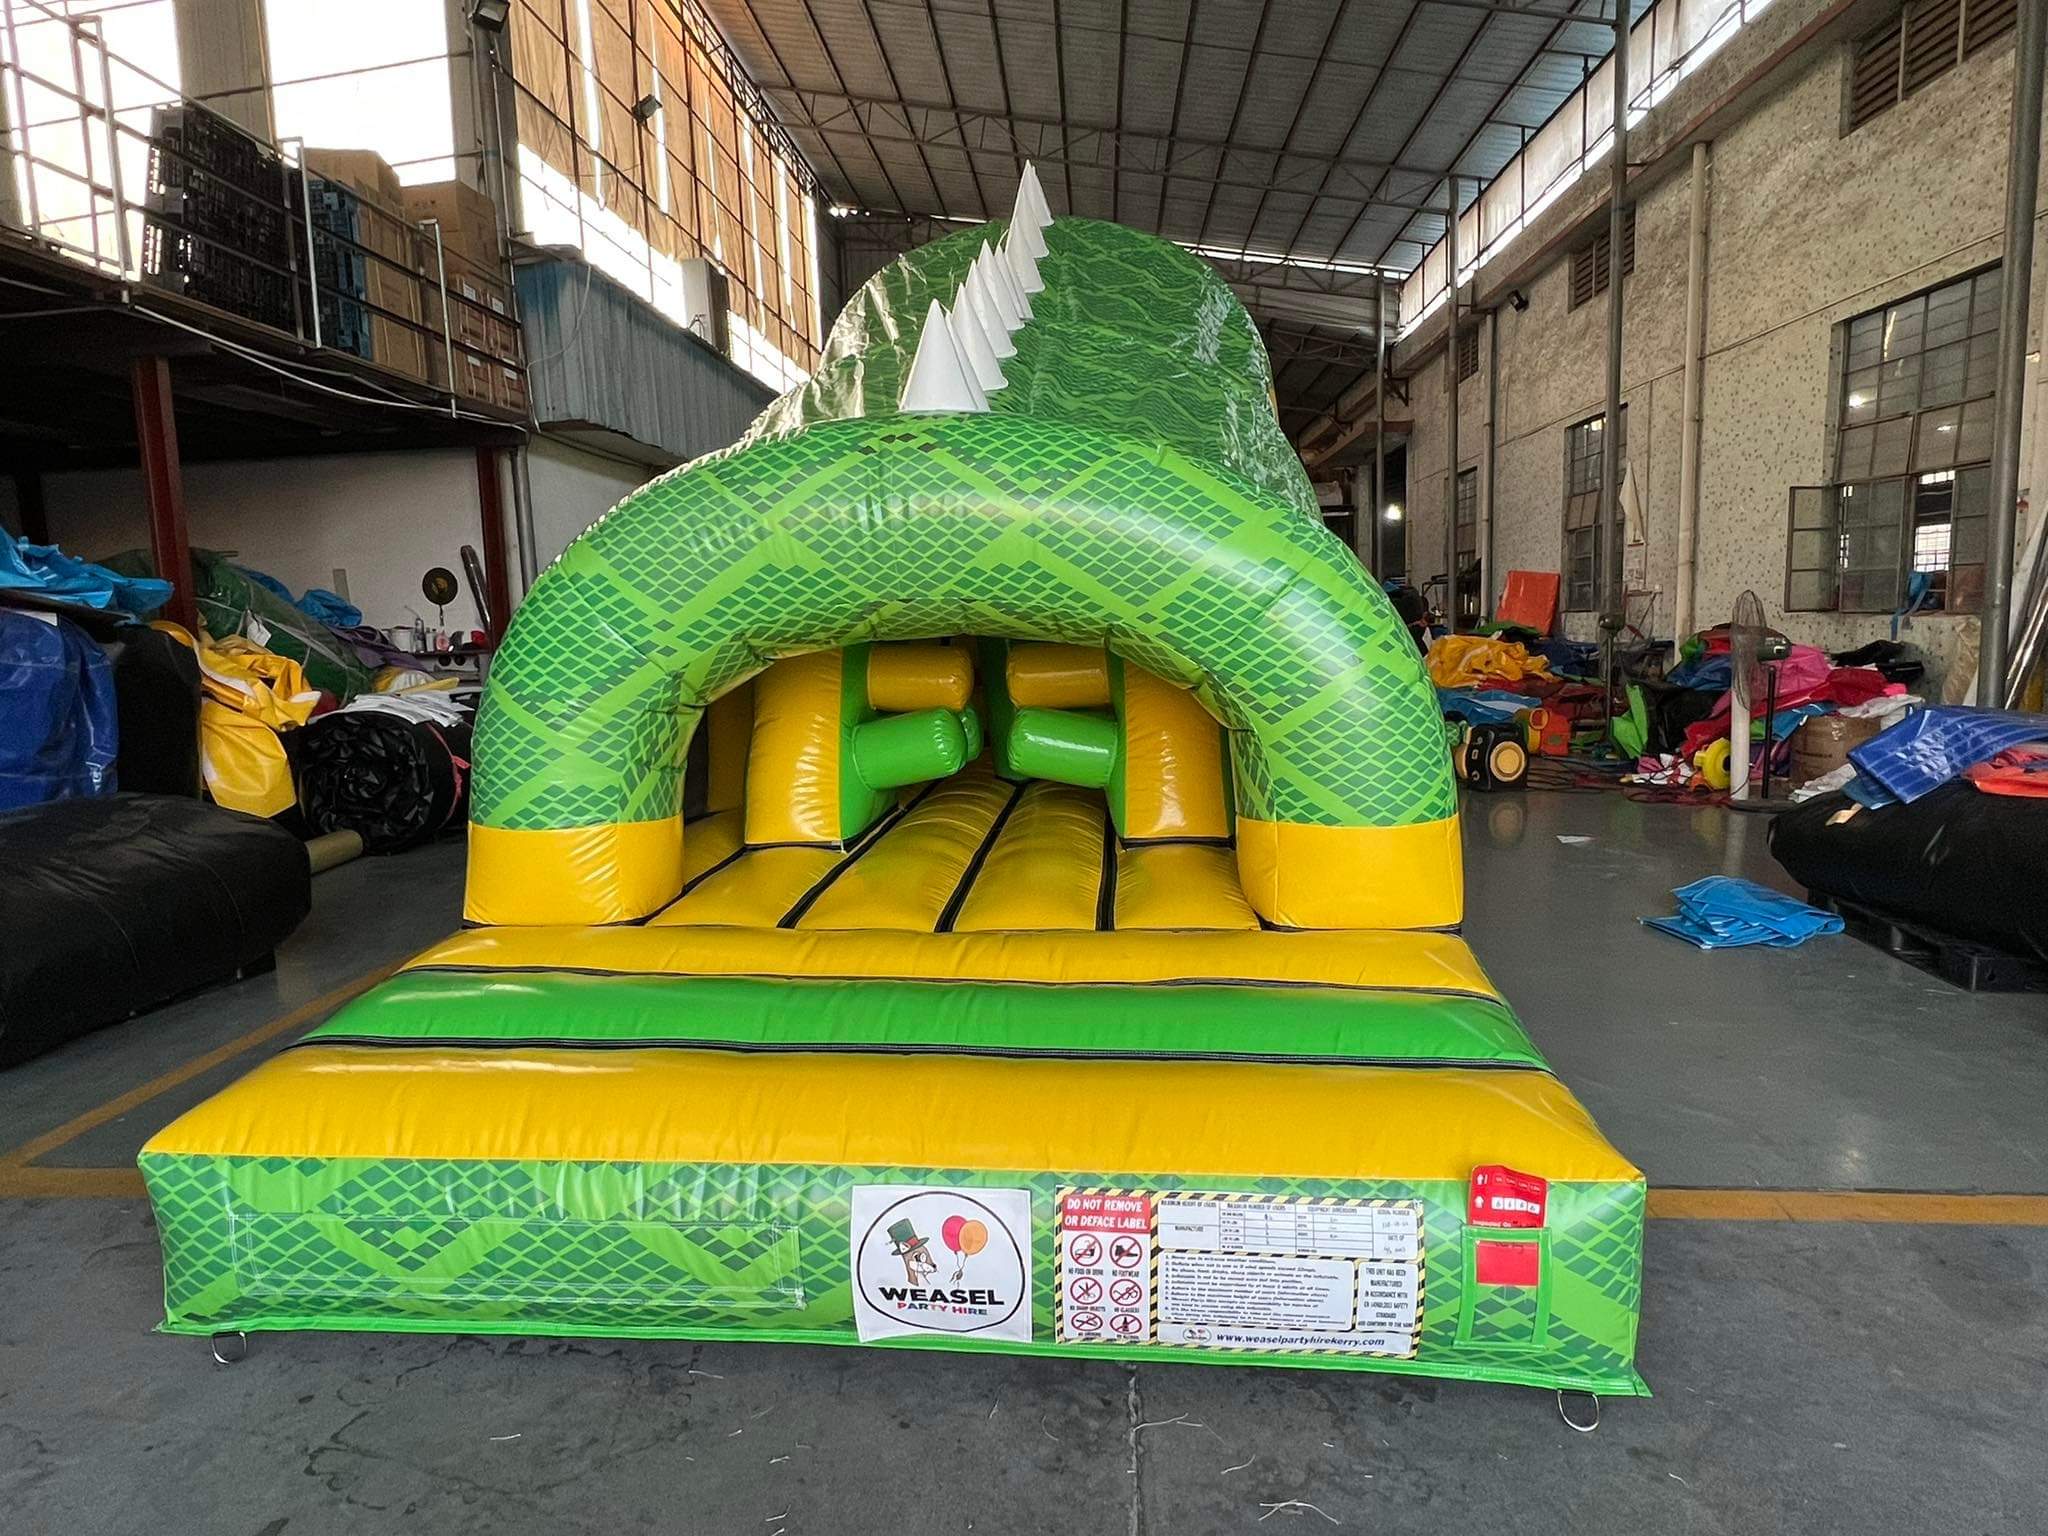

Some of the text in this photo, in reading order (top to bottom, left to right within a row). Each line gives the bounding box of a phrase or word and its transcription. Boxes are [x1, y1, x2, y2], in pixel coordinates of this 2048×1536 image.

[1067, 1198, 1143, 1212] DO NOT REMOVE
[1065, 1215, 1148, 1229] OR DEFACE LABEL
[879, 1287, 1005, 1305] WEASEL
[897, 1302, 988, 1315] PARTY HIRE
[1217, 1332, 1385, 1347] www.weaselpartyhirekerry.com
